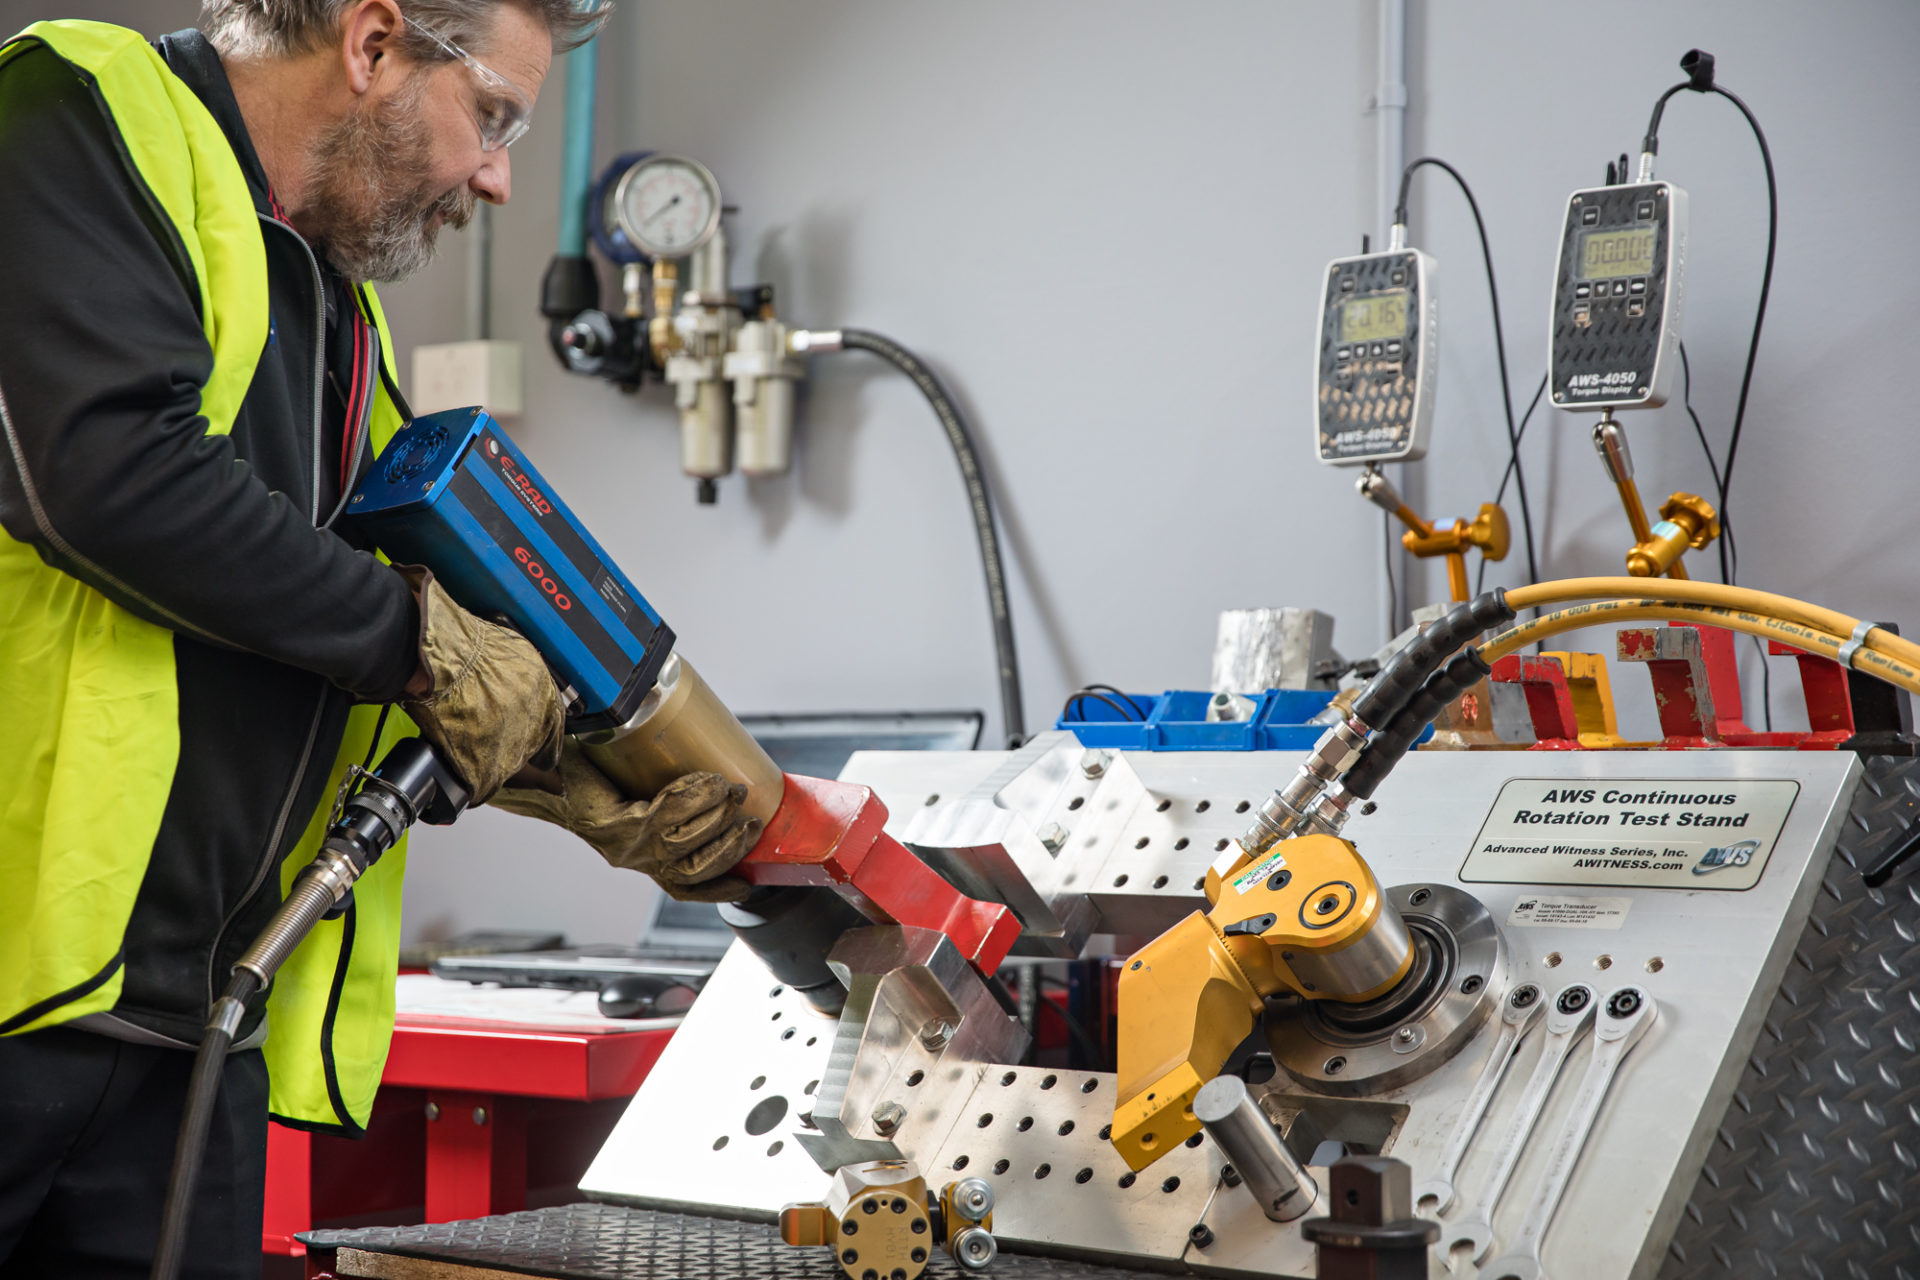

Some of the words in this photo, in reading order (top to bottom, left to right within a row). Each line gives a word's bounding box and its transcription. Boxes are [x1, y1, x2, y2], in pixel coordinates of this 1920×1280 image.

[1568, 371, 1637, 388] AWS-4050
[1601, 385, 1633, 395] Display
[500, 455, 551, 514] E-RAD
[502, 467, 521, 491] TORQUE
[520, 490, 543, 516] SYSTEMS
[514, 546, 571, 611] 6000
[1541, 789, 1596, 804] AWS
[1602, 790, 1737, 805] Continuous
[1513, 810, 1611, 825] Rotation
[1618, 811, 1671, 827] Test
[1676, 812, 1750, 828] Stand
[1483, 844, 1549, 855] Advanced
[1552, 845, 1606, 856] Witness
[1608, 846, 1657, 858] Series,
[1662, 847, 1688, 858] Inc.
[1700, 846, 1755, 866] AWS
[1572, 859, 1684, 871] AWITNESS.com
